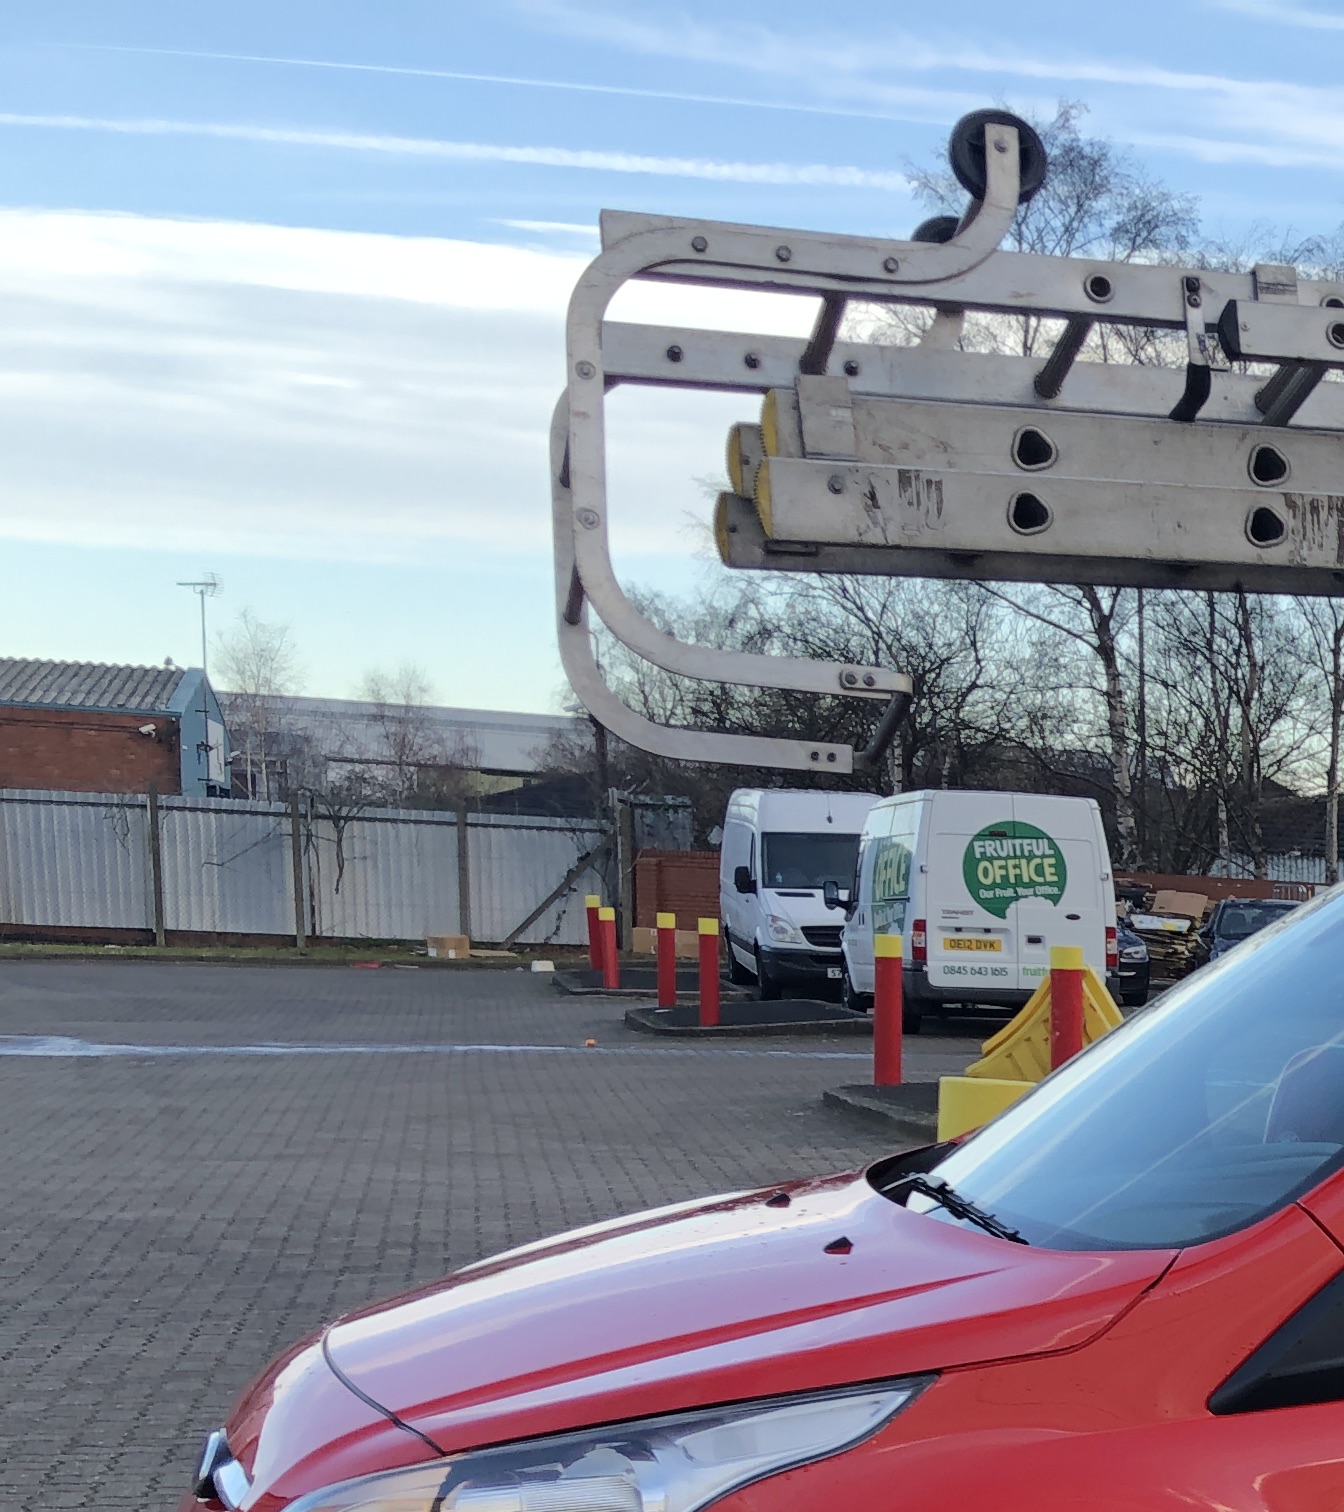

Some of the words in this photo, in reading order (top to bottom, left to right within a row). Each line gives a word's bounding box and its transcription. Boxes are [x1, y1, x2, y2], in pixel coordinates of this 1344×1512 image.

[973, 838, 1055, 858] FRUITFUL
[977, 857, 1059, 885] OFFICE
[943, 965, 968, 975] 0845
[970, 966, 988, 976] 643
